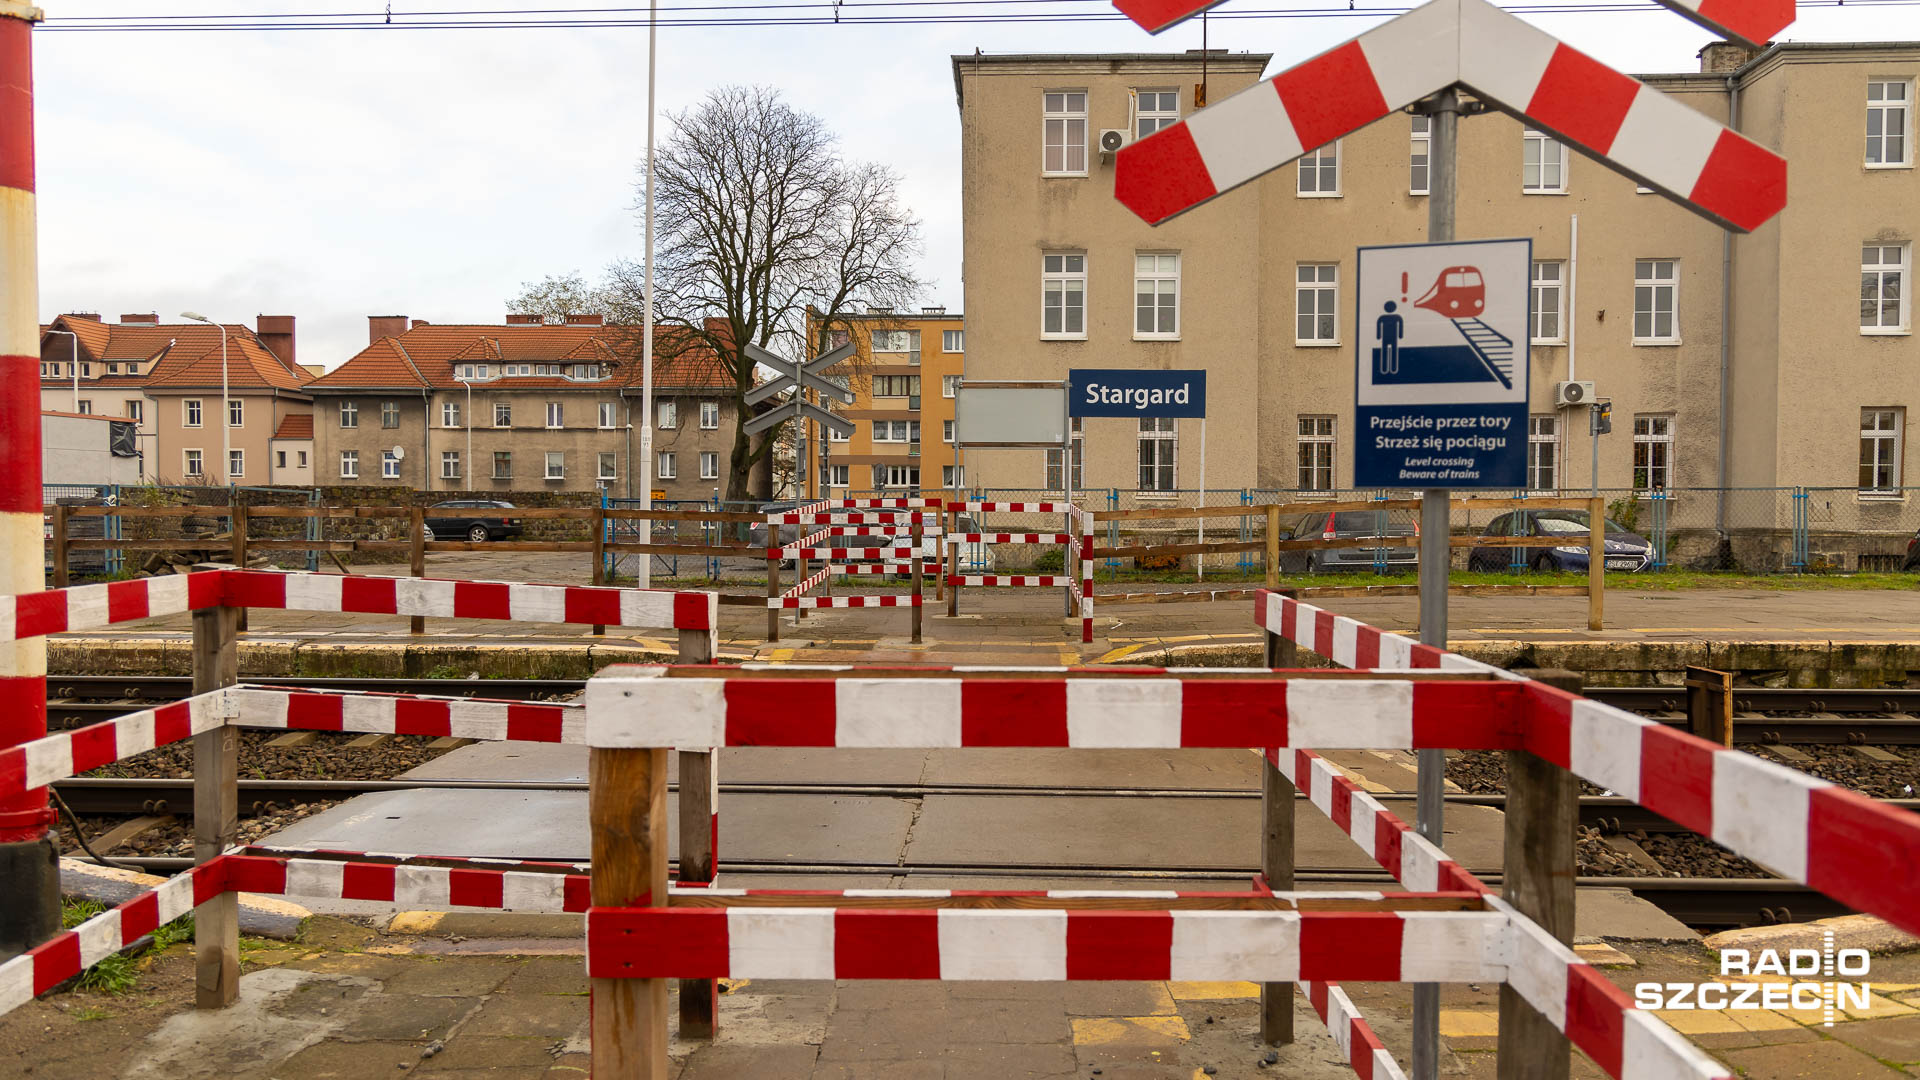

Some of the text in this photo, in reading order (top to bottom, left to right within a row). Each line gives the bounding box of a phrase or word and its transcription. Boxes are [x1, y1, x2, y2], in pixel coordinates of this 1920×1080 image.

[1086, 383, 1189, 409] Stargard
[1370, 415, 1511, 431] Przejście przez tory
[1375, 435, 1506, 451] Strzeż się pociągu
[1405, 456, 1475, 468] Level crossing
[1399, 469, 1480, 479] Beware of trains
